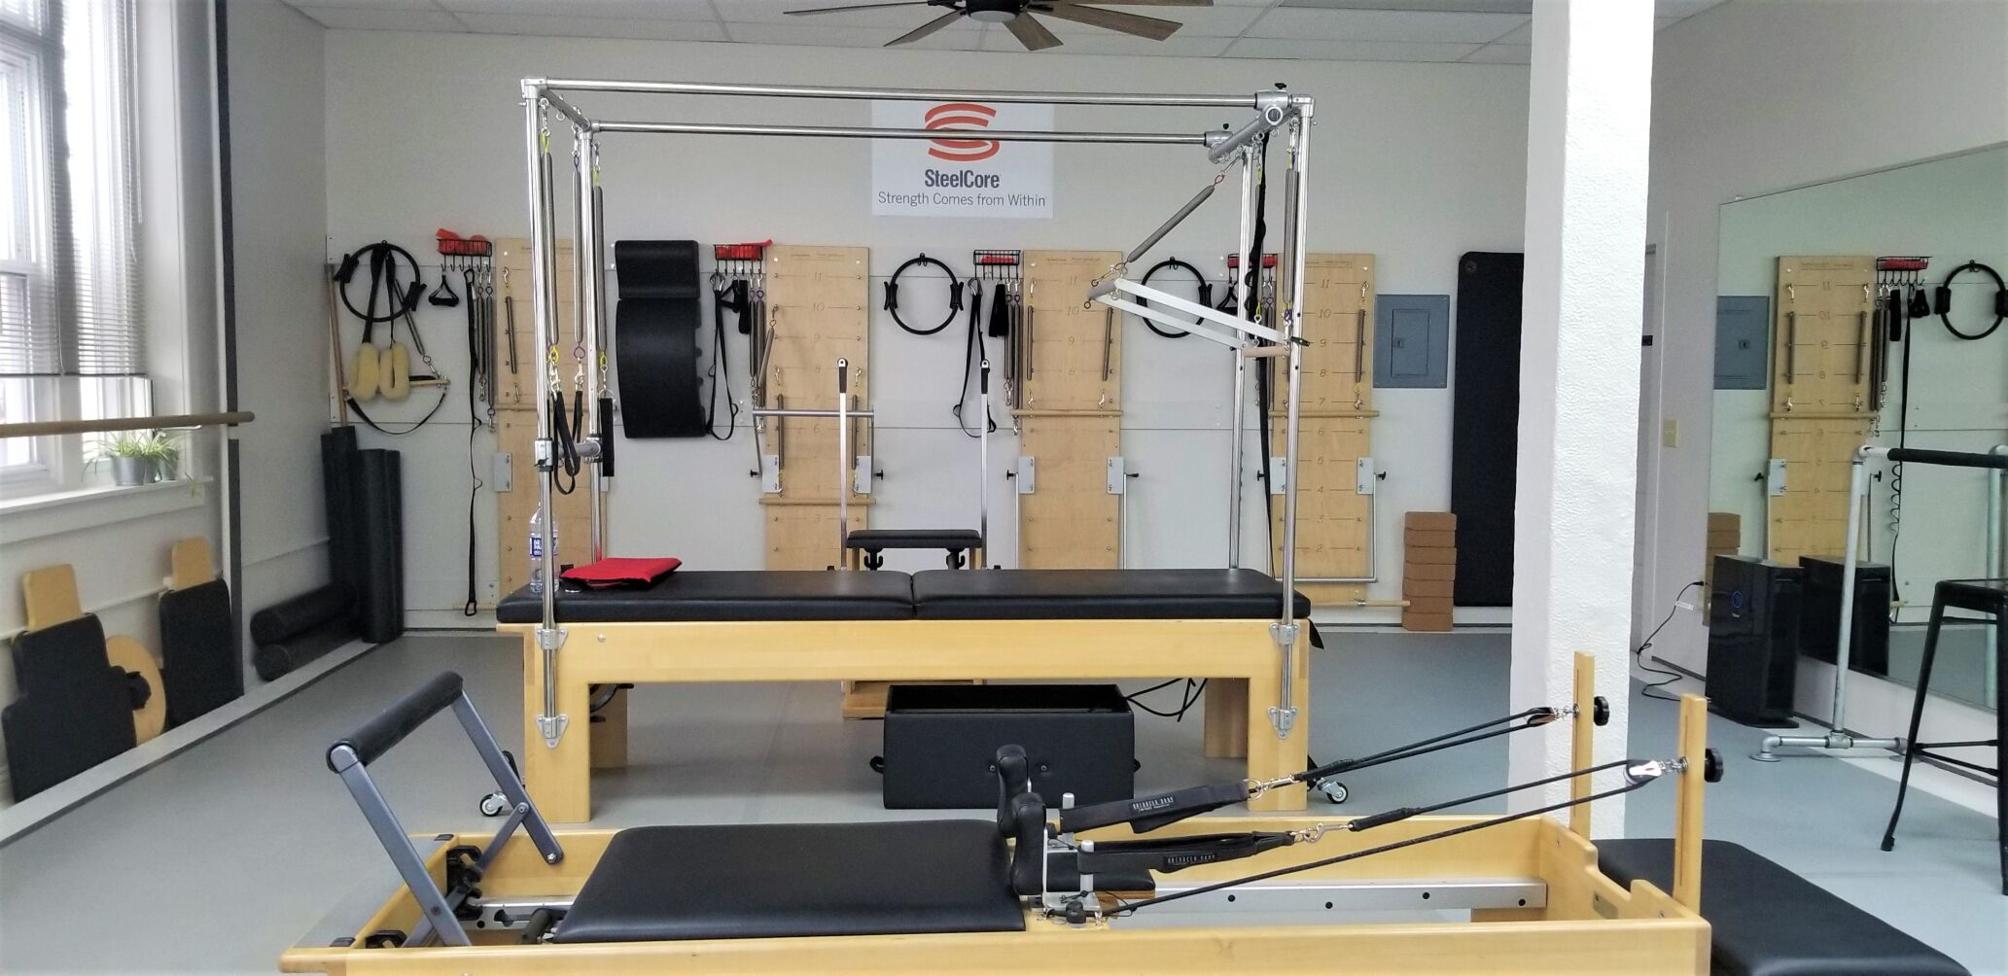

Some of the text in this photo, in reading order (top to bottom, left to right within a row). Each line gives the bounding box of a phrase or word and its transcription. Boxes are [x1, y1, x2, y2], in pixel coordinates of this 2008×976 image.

[924, 168, 1000, 188] SteelCore
[878, 191, 1046, 207] Strength Comes from Within
[1320, 279, 1331, 289] 11
[1318, 308, 1332, 319] 10
[1319, 338, 1328, 348] 9
